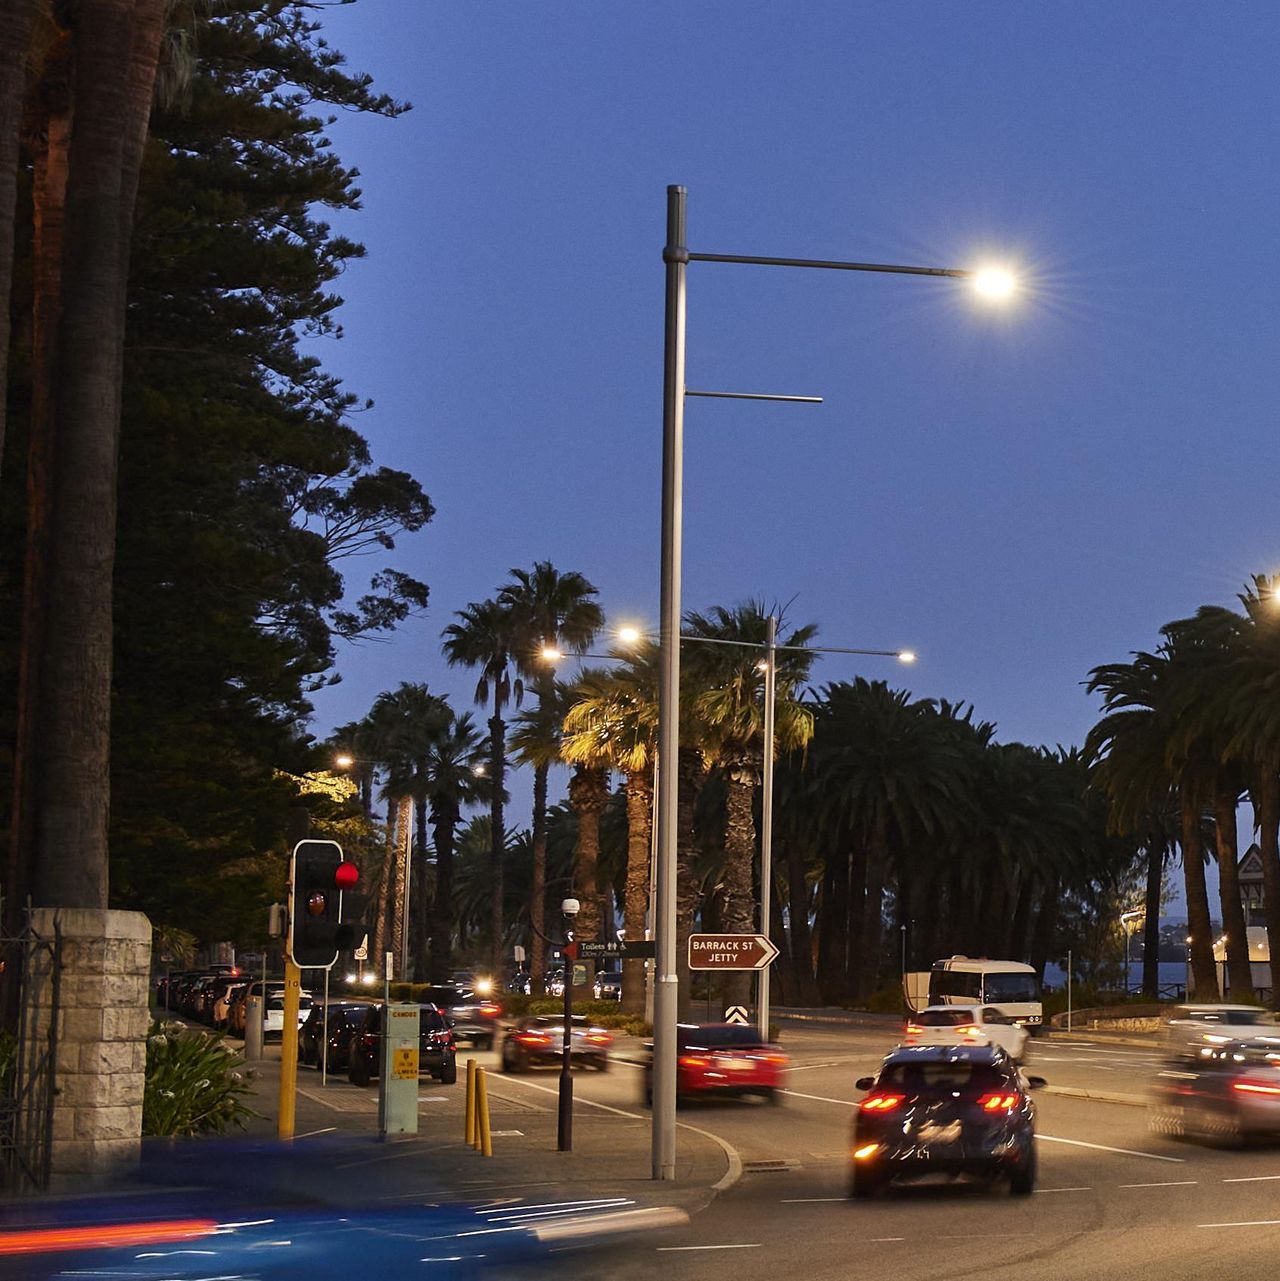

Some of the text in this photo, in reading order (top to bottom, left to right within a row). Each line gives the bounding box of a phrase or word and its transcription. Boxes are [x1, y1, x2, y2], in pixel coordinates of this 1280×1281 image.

[581, 942, 606, 951] Toilets
[693, 941, 754, 951] BARRACK ST
[708, 953, 738, 962] JETTY
